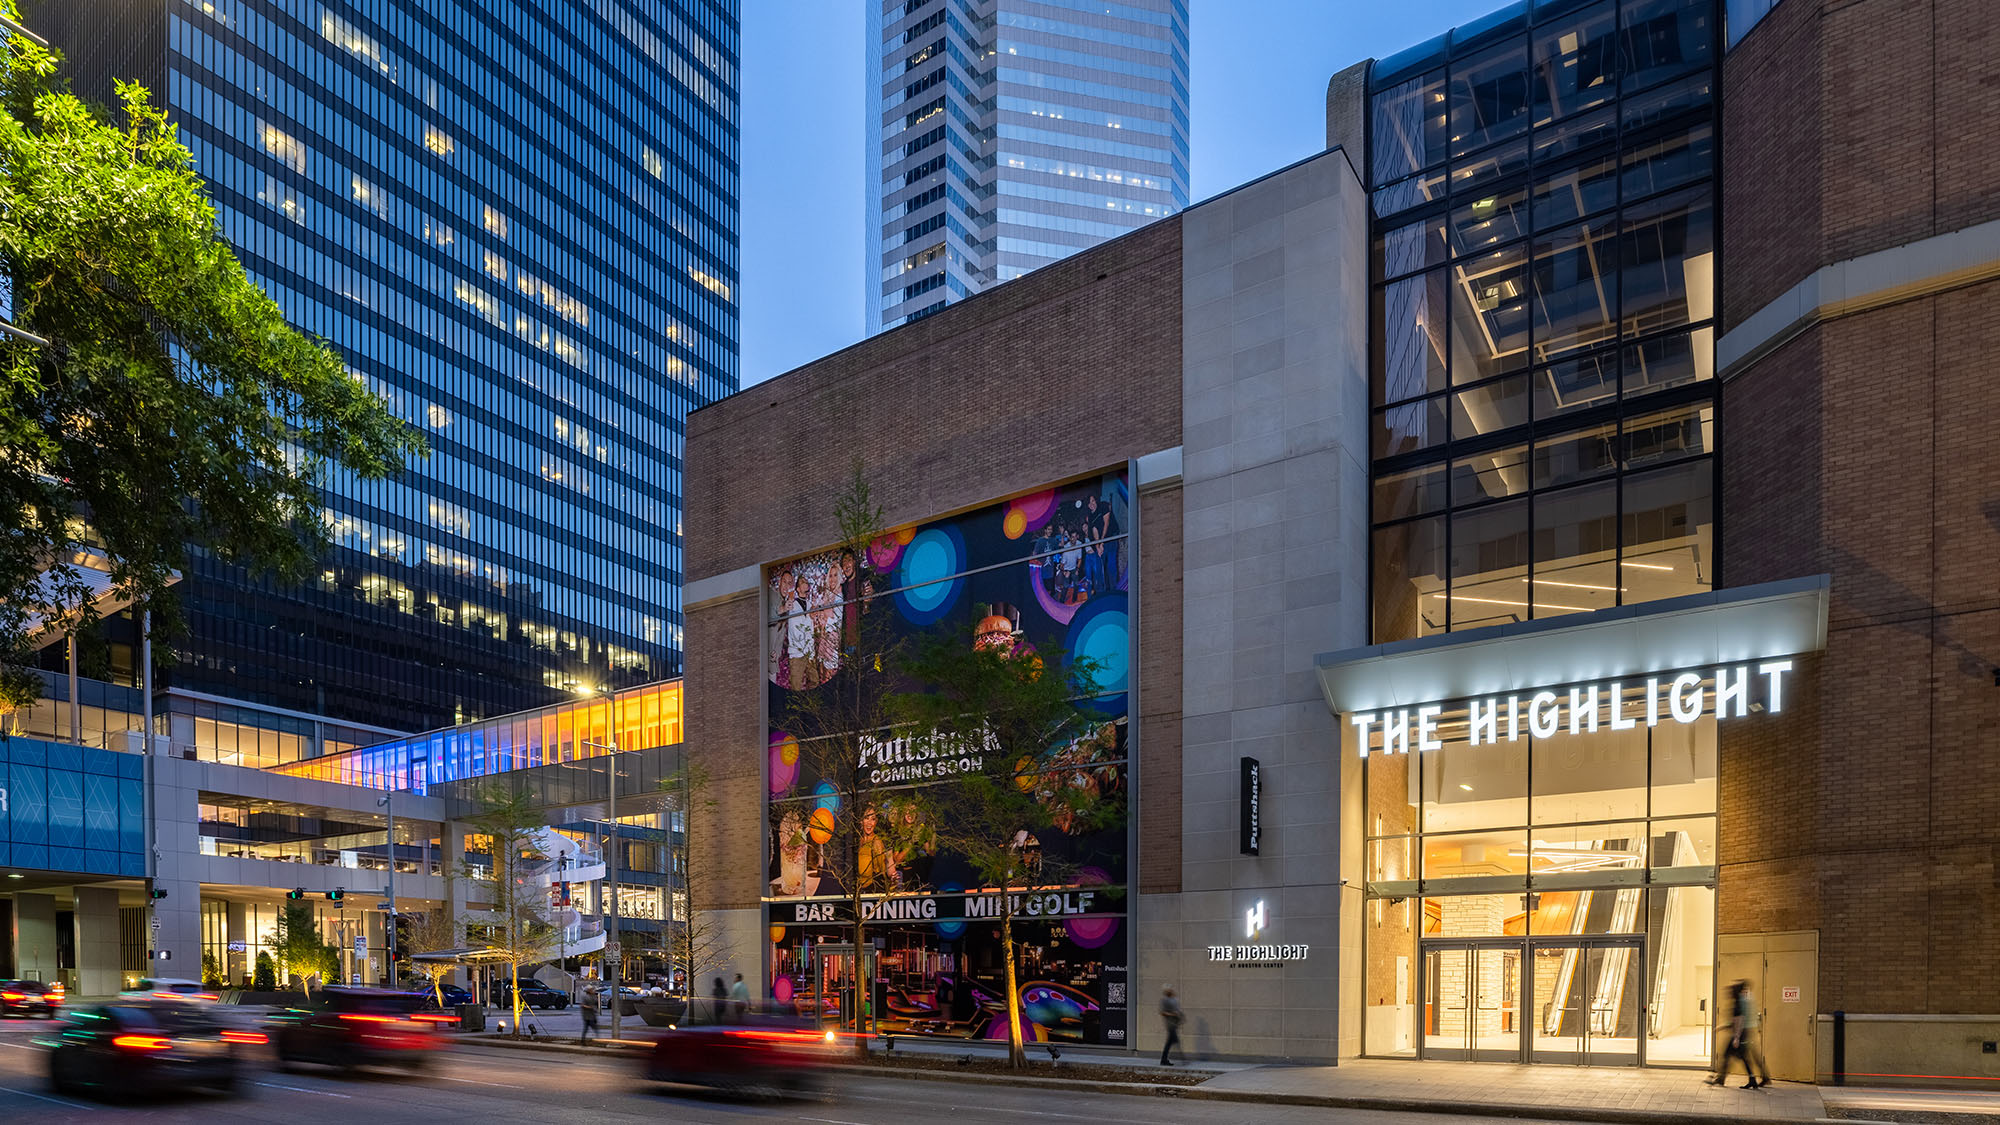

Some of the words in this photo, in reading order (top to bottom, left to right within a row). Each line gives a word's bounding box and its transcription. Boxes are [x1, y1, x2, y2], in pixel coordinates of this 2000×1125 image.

[1351, 705, 1442, 758] THE
[1470, 660, 1793, 746] HIGHLIGHT
[870, 762, 933, 783] COMING
[936, 756, 983, 776] SOON
[1250, 764, 1258, 849] Puttshack
[795, 903, 835, 922] BAR
[861, 899, 937, 920] DINING
[1026, 892, 1095, 916] GOLF
[1207, 946, 1232, 960] THE
[1236, 945, 1309, 960] HIGHLIGHT
